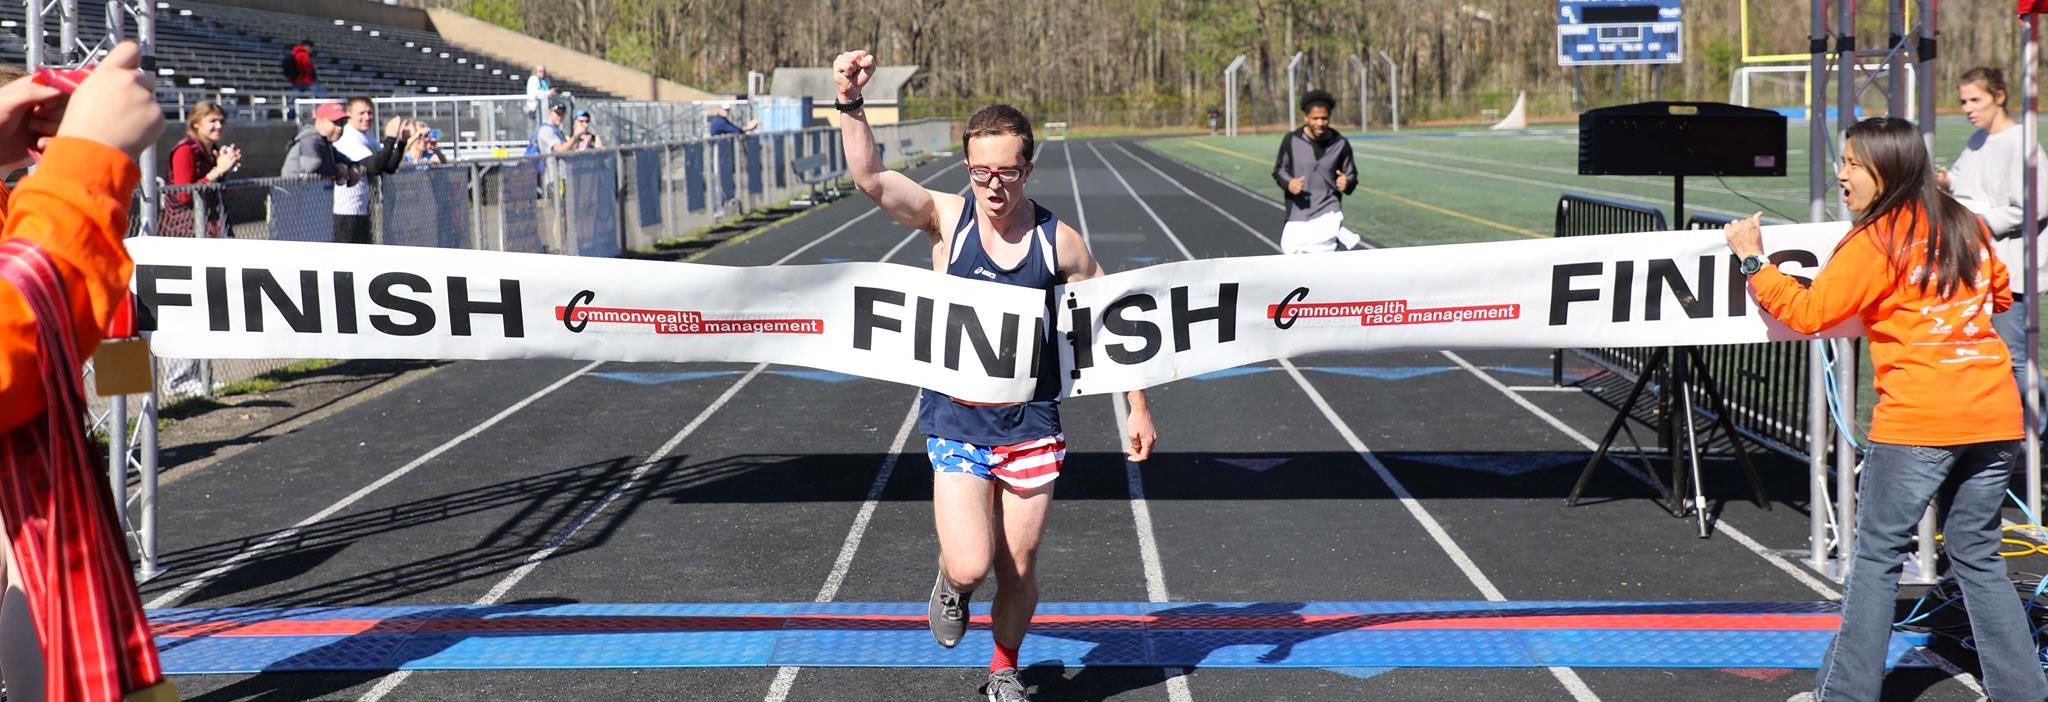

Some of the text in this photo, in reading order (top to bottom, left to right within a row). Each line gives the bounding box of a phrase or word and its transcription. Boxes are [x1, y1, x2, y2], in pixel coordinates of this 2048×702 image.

[136, 264, 524, 338] FINISH
[1274, 286, 1406, 330] Commonwealth
[563, 289, 700, 333] Commonwealth
[1366, 313, 1403, 325] race
[1407, 304, 1514, 323] management
[660, 322, 700, 333] race
[705, 318, 818, 333] management
